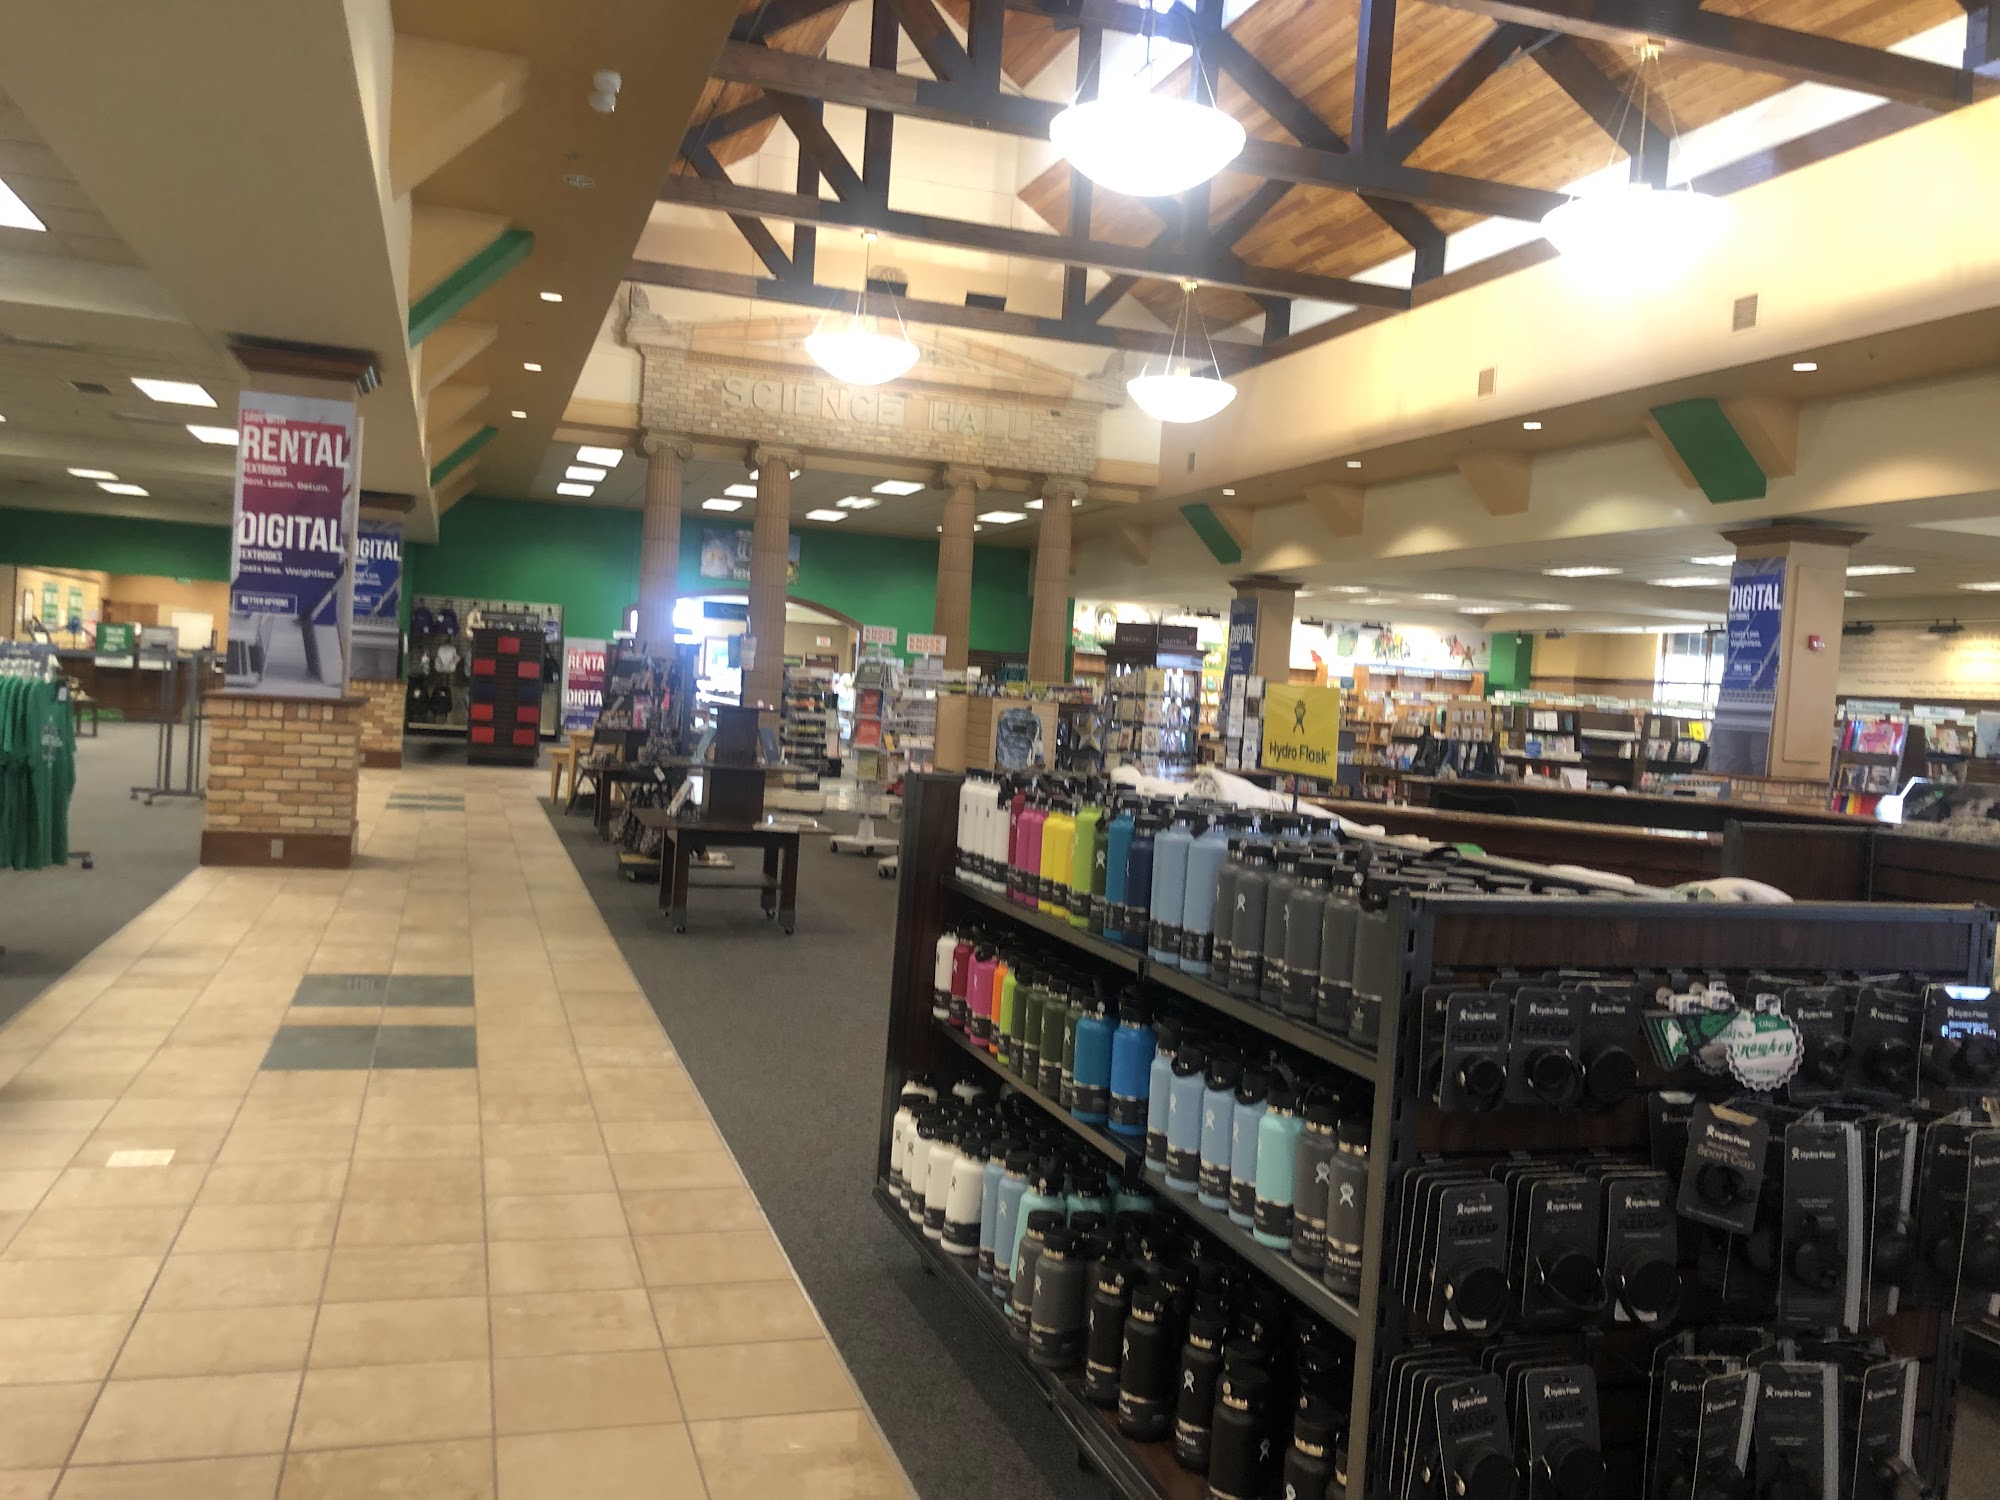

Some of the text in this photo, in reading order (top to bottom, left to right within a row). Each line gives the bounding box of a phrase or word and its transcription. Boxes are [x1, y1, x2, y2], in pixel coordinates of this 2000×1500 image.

[722, 375, 906, 425] SCIENCE
[242, 424, 350, 468] RENTAL
[238, 511, 345, 553] DIGITAL
[355, 537, 402, 562] IGITAL
[1729, 583, 1782, 611] DIGITAL
[1230, 623, 1254, 644] DIGITAL
[1269, 740, 1327, 765] Hydro Flask
[1697, 1143, 1728, 1163] Sport
[1730, 1152, 1756, 1171] Cap
